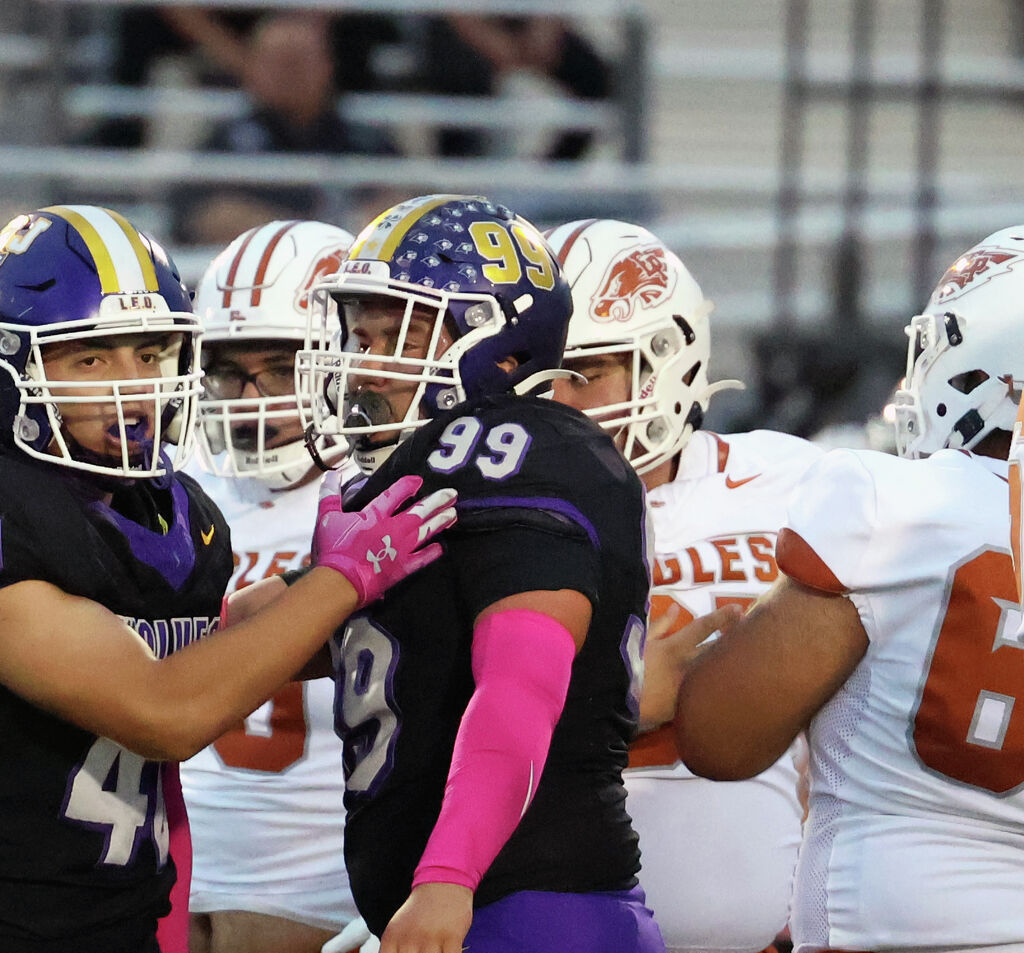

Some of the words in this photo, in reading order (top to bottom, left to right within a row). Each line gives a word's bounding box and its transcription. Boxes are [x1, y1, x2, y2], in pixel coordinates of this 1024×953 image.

[468, 221, 556, 291] 99
[427, 415, 532, 482] 99
[653, 536, 779, 586] GLES
